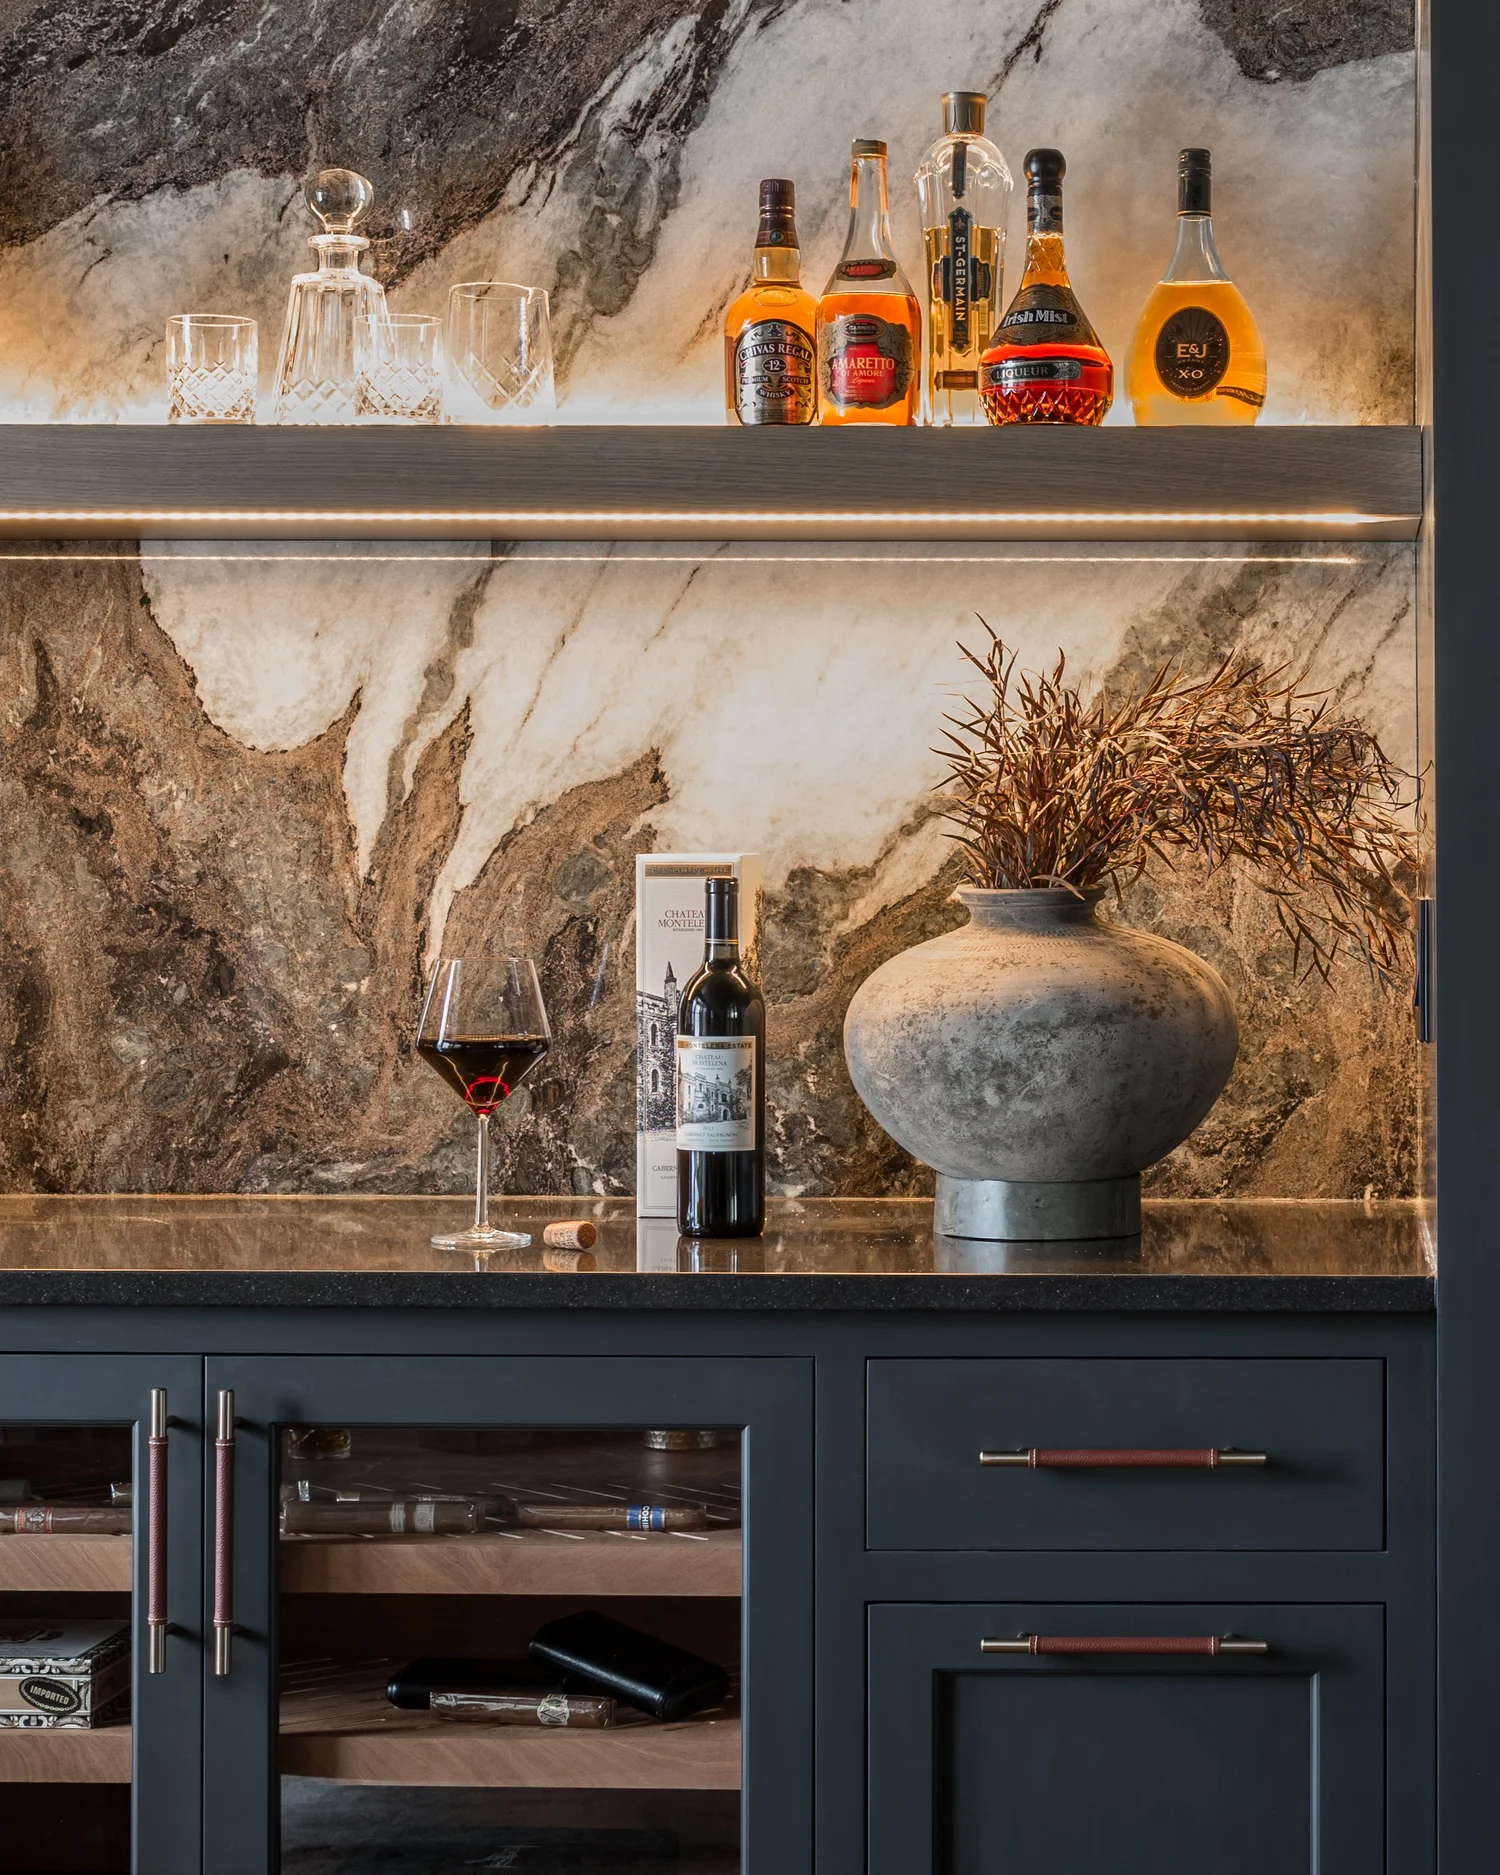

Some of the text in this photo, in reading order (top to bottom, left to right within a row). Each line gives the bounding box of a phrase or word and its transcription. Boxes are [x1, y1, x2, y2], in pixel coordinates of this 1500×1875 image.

[1003, 311, 1034, 328] Irish
[1035, 309, 1069, 324] Mist
[740, 343, 811, 361] CHIVAS REGAL
[1177, 343, 1207, 359] E&J
[769, 359, 780, 371] 12
[831, 357, 895, 371] AMARETTO
[852, 369, 885, 377] AMORE
[996, 366, 1049, 379] LIQUEUR
[741, 375, 809, 385] PRMIUM SCOTCH
[760, 388, 791, 399] WHISKY
[664, 909, 705, 919] CHATEA
[658, 919, 705, 928] MONTELE
[727, 1041, 753, 1049] ESTATE
[641, 1505, 651, 1530] COHIB
[30, 1685, 70, 1705] IMPORTED
